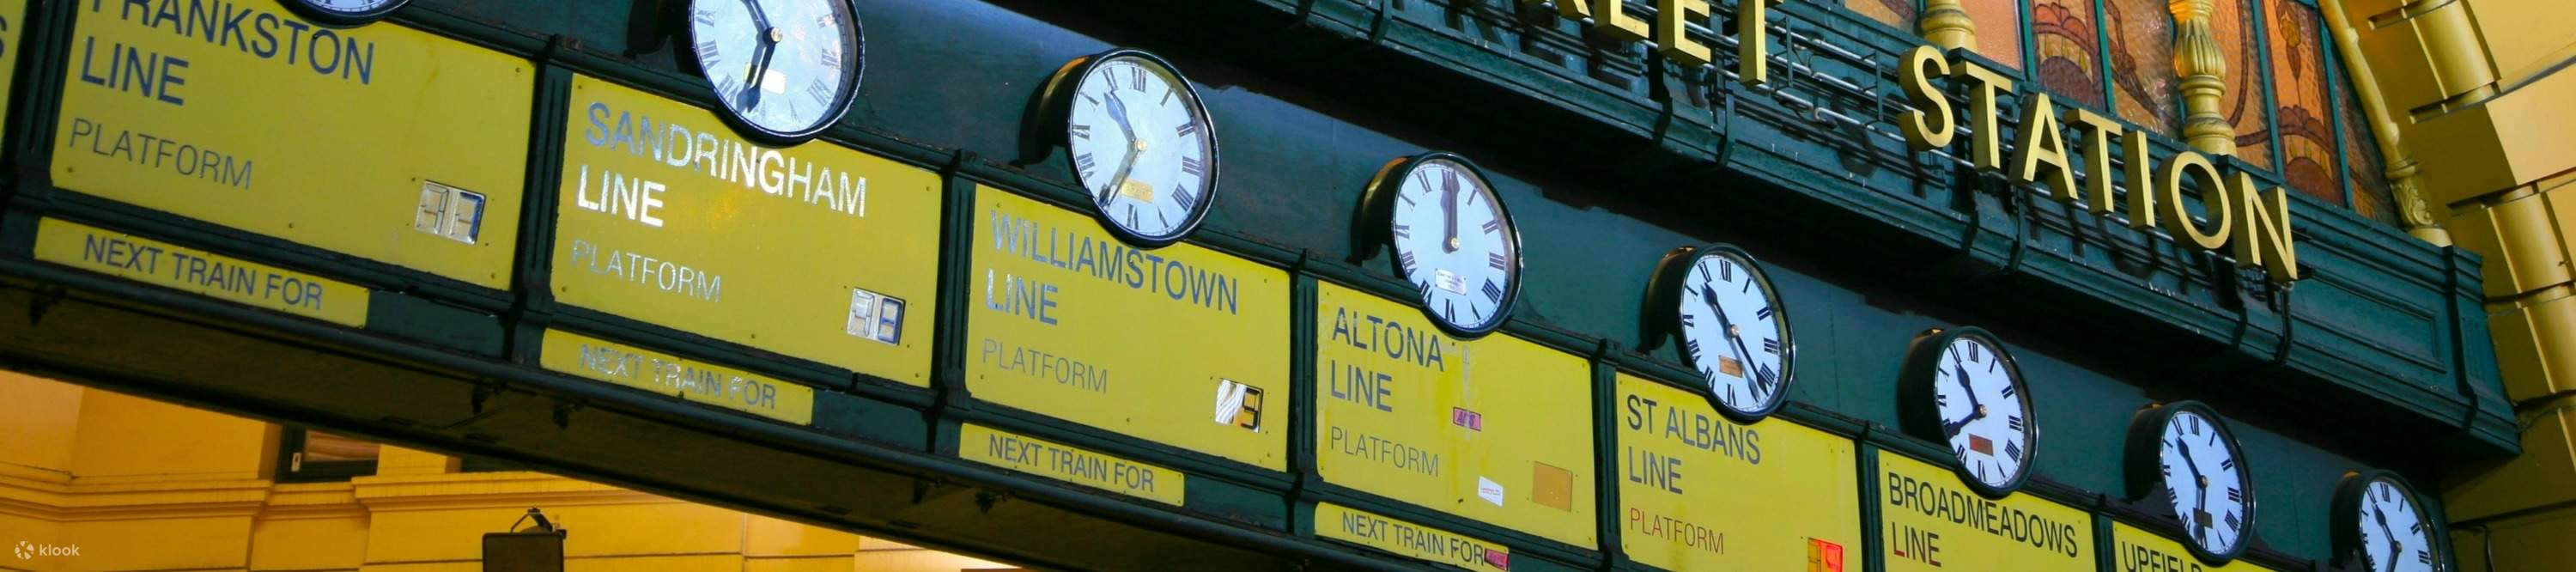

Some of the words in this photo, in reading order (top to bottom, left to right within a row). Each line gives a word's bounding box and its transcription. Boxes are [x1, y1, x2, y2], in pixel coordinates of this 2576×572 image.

[81, 36, 189, 106] LINE
[92, 0, 374, 85] RANKSTON
[1557, 0, 1783, 85] ET
[69, 117, 252, 191] PLATFORM
[585, 101, 866, 219] SANDRINGHAM
[1899, 45, 2299, 283] STATION
[577, 165, 666, 228] LINE
[85, 234, 163, 274] NEXT
[173, 252, 257, 296] TRAIN
[264, 273, 322, 310] FOR
[572, 239, 722, 304] PLATFORM
[991, 210, 1237, 316] WILLIAMSTOWN
[984, 268, 1059, 326] LINE
[982, 338, 1109, 394] PLATFORM
[1332, 307, 1444, 372] ALTONA
[579, 344, 644, 378] NEXT
[652, 358, 721, 399] TRAIN
[729, 376, 777, 410] FOR
[1330, 360, 1393, 412] LINE
[1330, 426, 1439, 478] PLATFORM
[1627, 394, 1657, 432] ST
[1665, 406, 1762, 466] ALBANS
[988, 434, 1042, 468] NEXT
[1048, 447, 1108, 483] TRAIN
[1115, 464, 1154, 494] FOR
[1628, 446, 1683, 495] LINE
[1342, 511, 1388, 540] NEXT
[1394, 524, 1445, 556] TRAIN
[1450, 538, 1484, 566] FOR
[1629, 508, 1725, 556] PLATFORM
[1888, 472, 2079, 559] BROADMEADOWS
[1892, 522, 1942, 568] LINE
